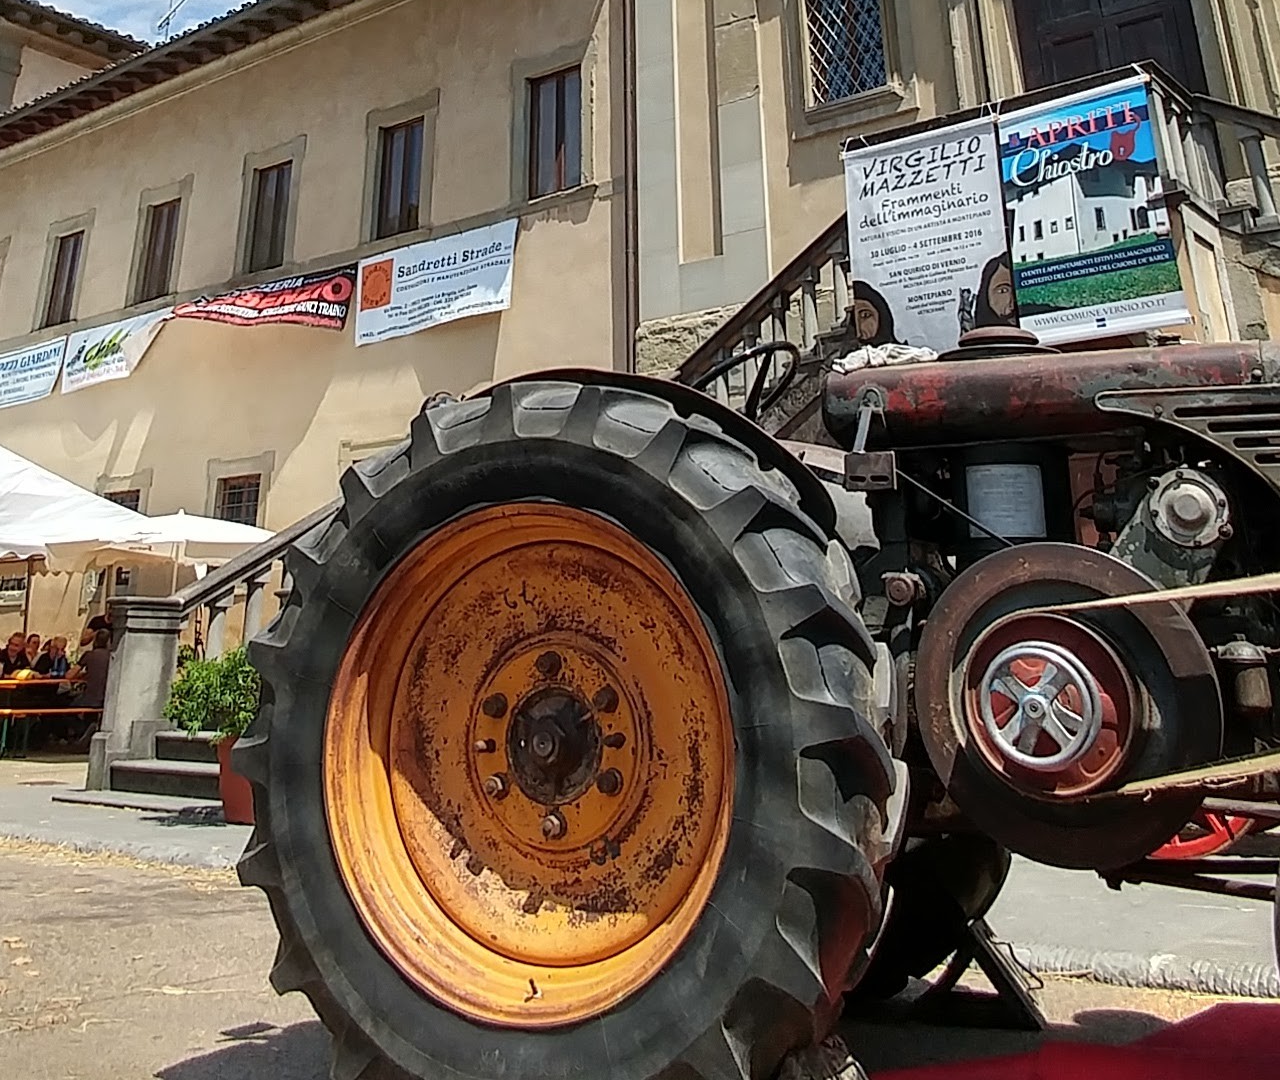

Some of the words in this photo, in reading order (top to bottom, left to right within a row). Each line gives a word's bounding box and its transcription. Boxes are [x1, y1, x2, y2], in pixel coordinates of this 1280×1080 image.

[863, 135, 981, 181] VIRGILIO
[1010, 141, 1113, 187] Chiostro
[859, 154, 986, 201] MAZZETTI
[859, 192, 989, 229] dell'immaginario
[881, 183, 962, 211] Frammenti
[397, 252, 458, 279] Sandretti
[461, 241, 502, 263] Strade
[880, 244, 907, 257] LUGLIO
[919, 232, 962, 249] SETTEMBRE
[964, 228, 983, 240] 2016
[889, 270, 902, 279] SAN
[903, 264, 931, 276] QUIRICO
[931, 262, 940, 270] DI
[939, 257, 966, 269] VERNIO
[907, 289, 953, 303] MONTEPIANO
